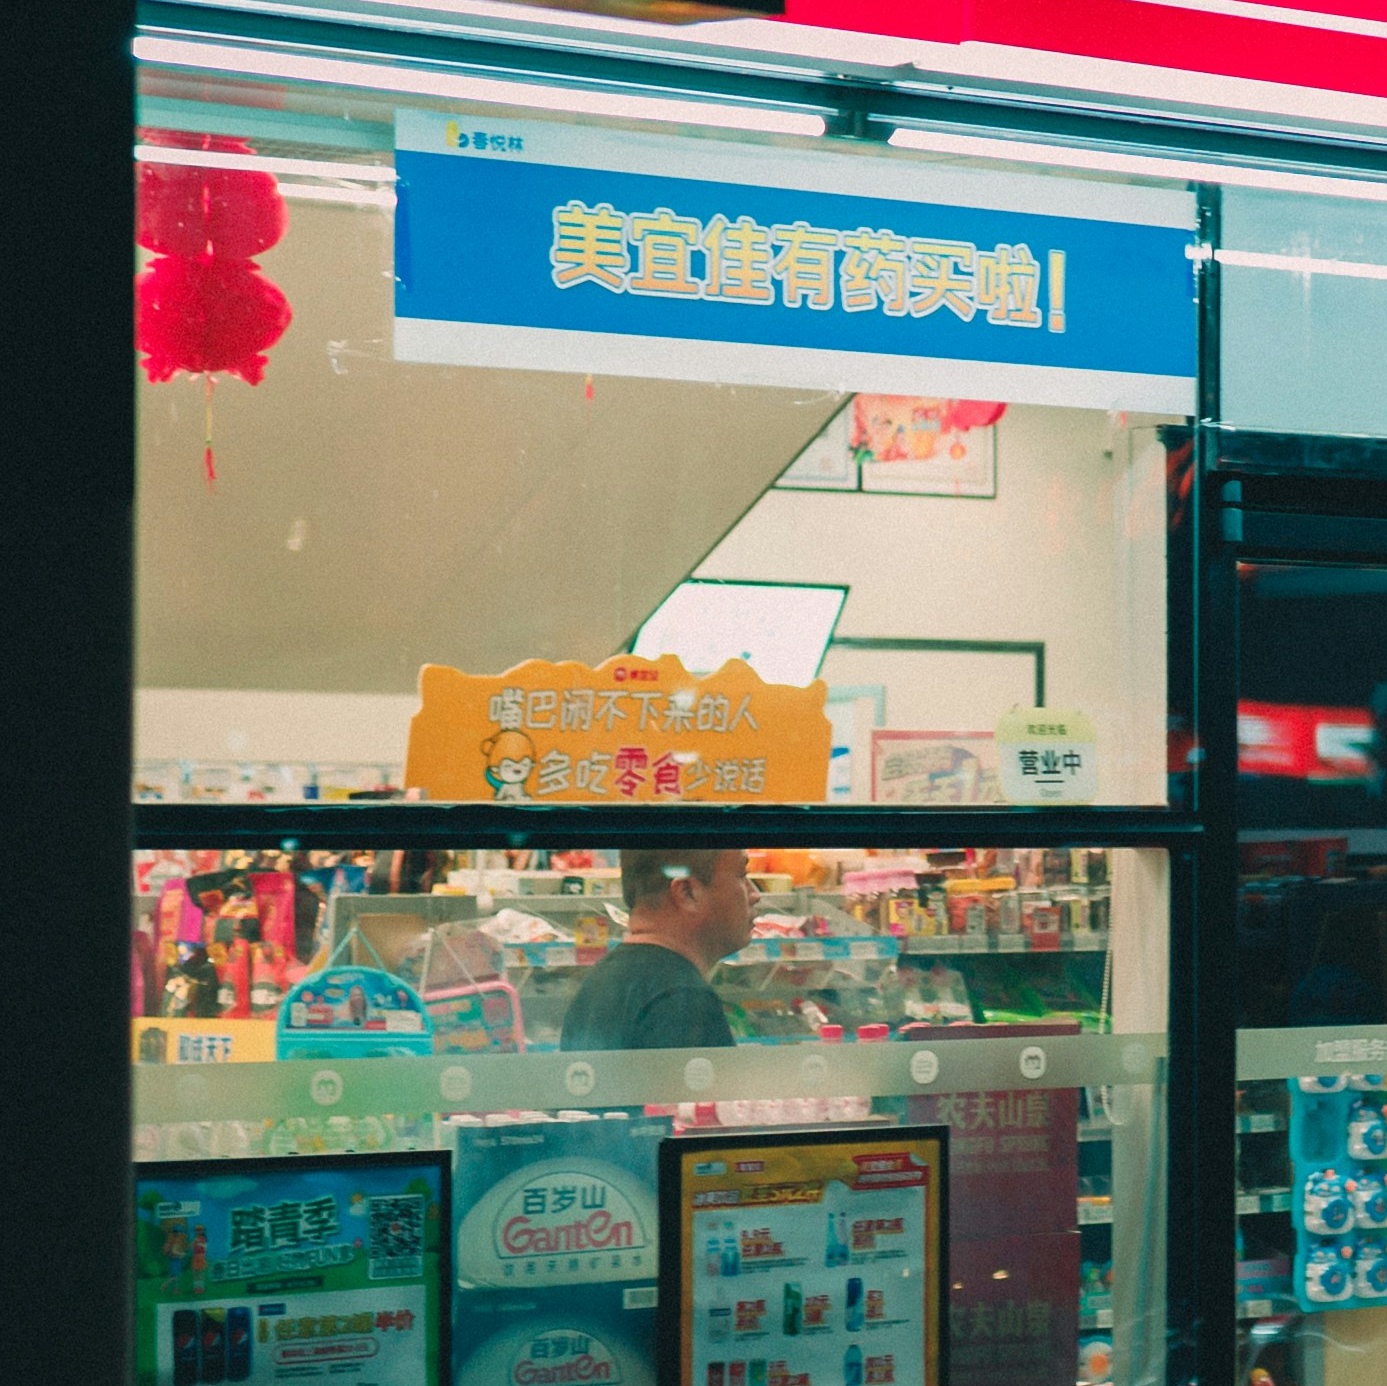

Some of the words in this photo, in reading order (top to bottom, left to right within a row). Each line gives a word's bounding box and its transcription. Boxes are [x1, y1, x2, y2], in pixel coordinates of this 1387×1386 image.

[552, 201, 1066, 333] 美宜佳有药买啦！
[536, 747, 768, 798] 多吃零食少说话
[1018, 749, 1082, 776] 营业中
[523, 1184, 606, 1215] 百岁山
